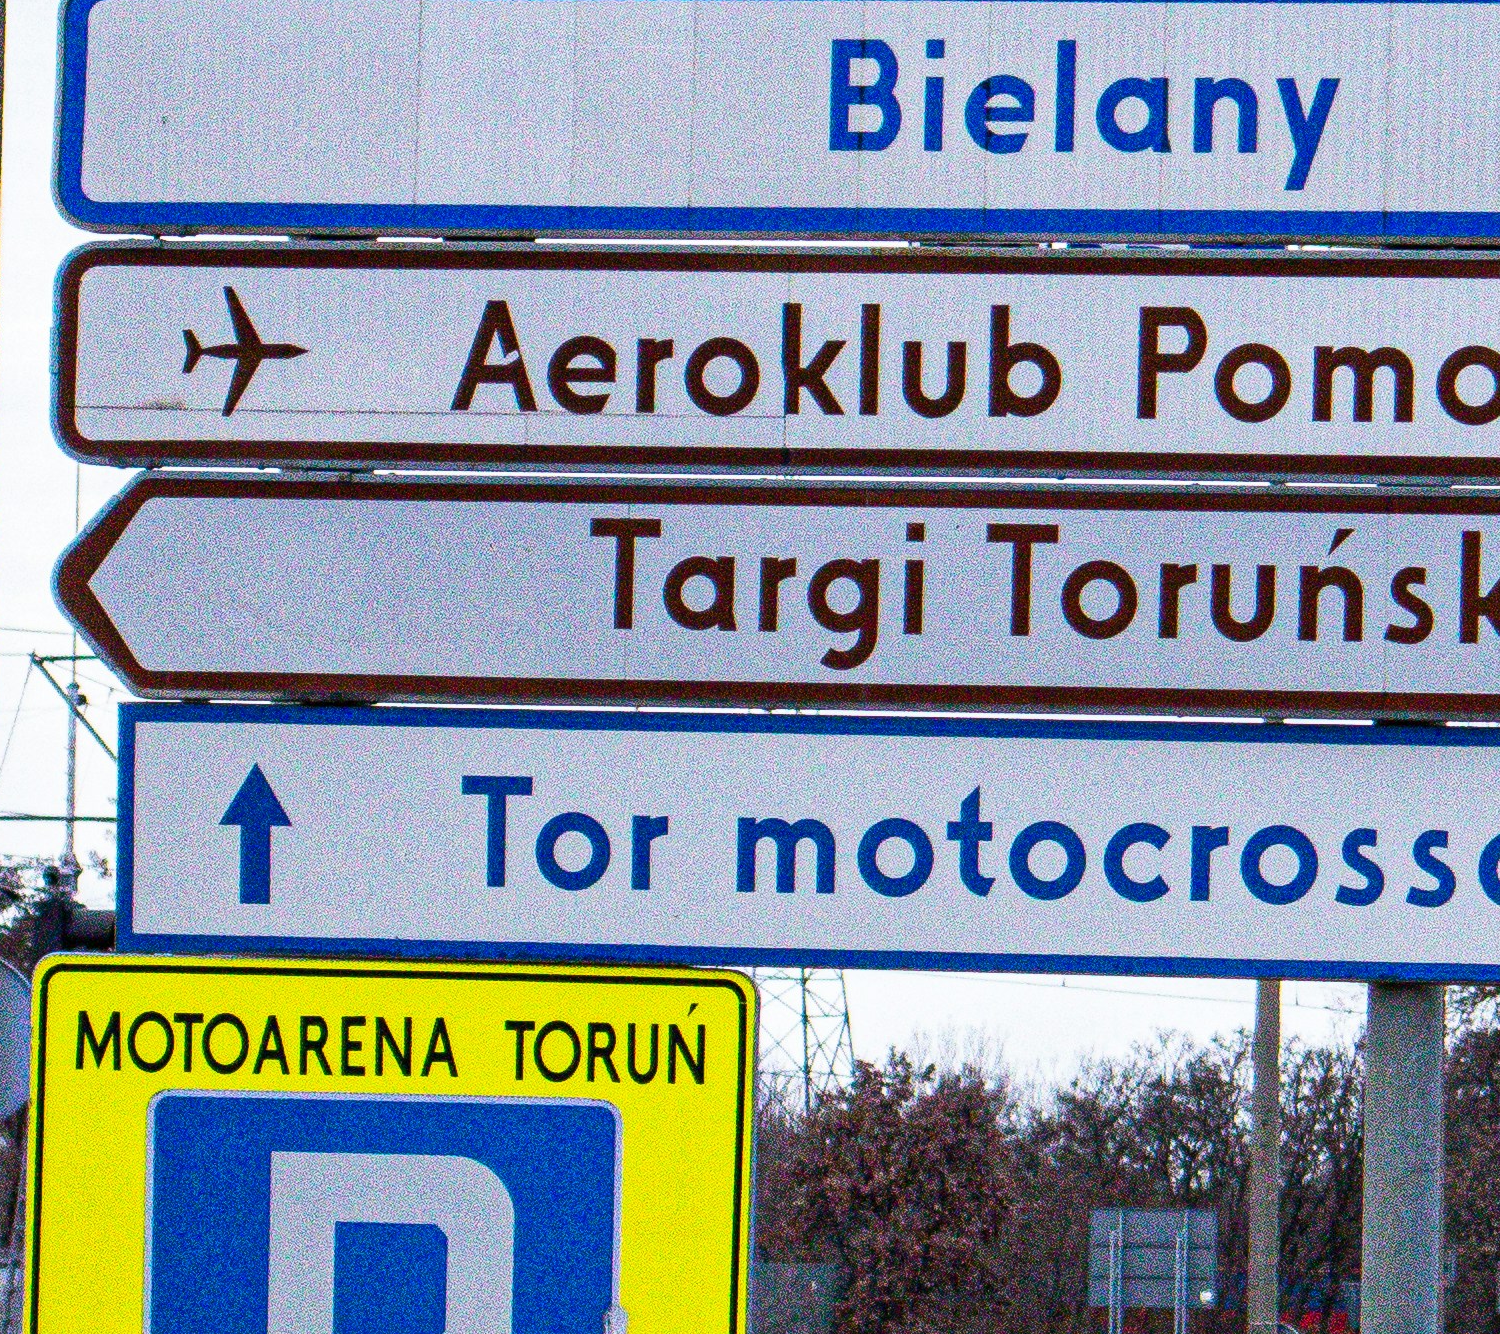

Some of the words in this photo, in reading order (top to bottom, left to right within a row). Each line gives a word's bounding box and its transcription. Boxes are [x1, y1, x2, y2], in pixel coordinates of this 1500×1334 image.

[830, 39, 1339, 190] Bielany
[452, 300, 1062, 418] Aeroklub
[591, 518, 925, 670] Targi
[463, 776, 668, 890] Tor
[76, 1010, 457, 1078] MOTOARENA
[505, 1003, 706, 1086] TORUŃ
